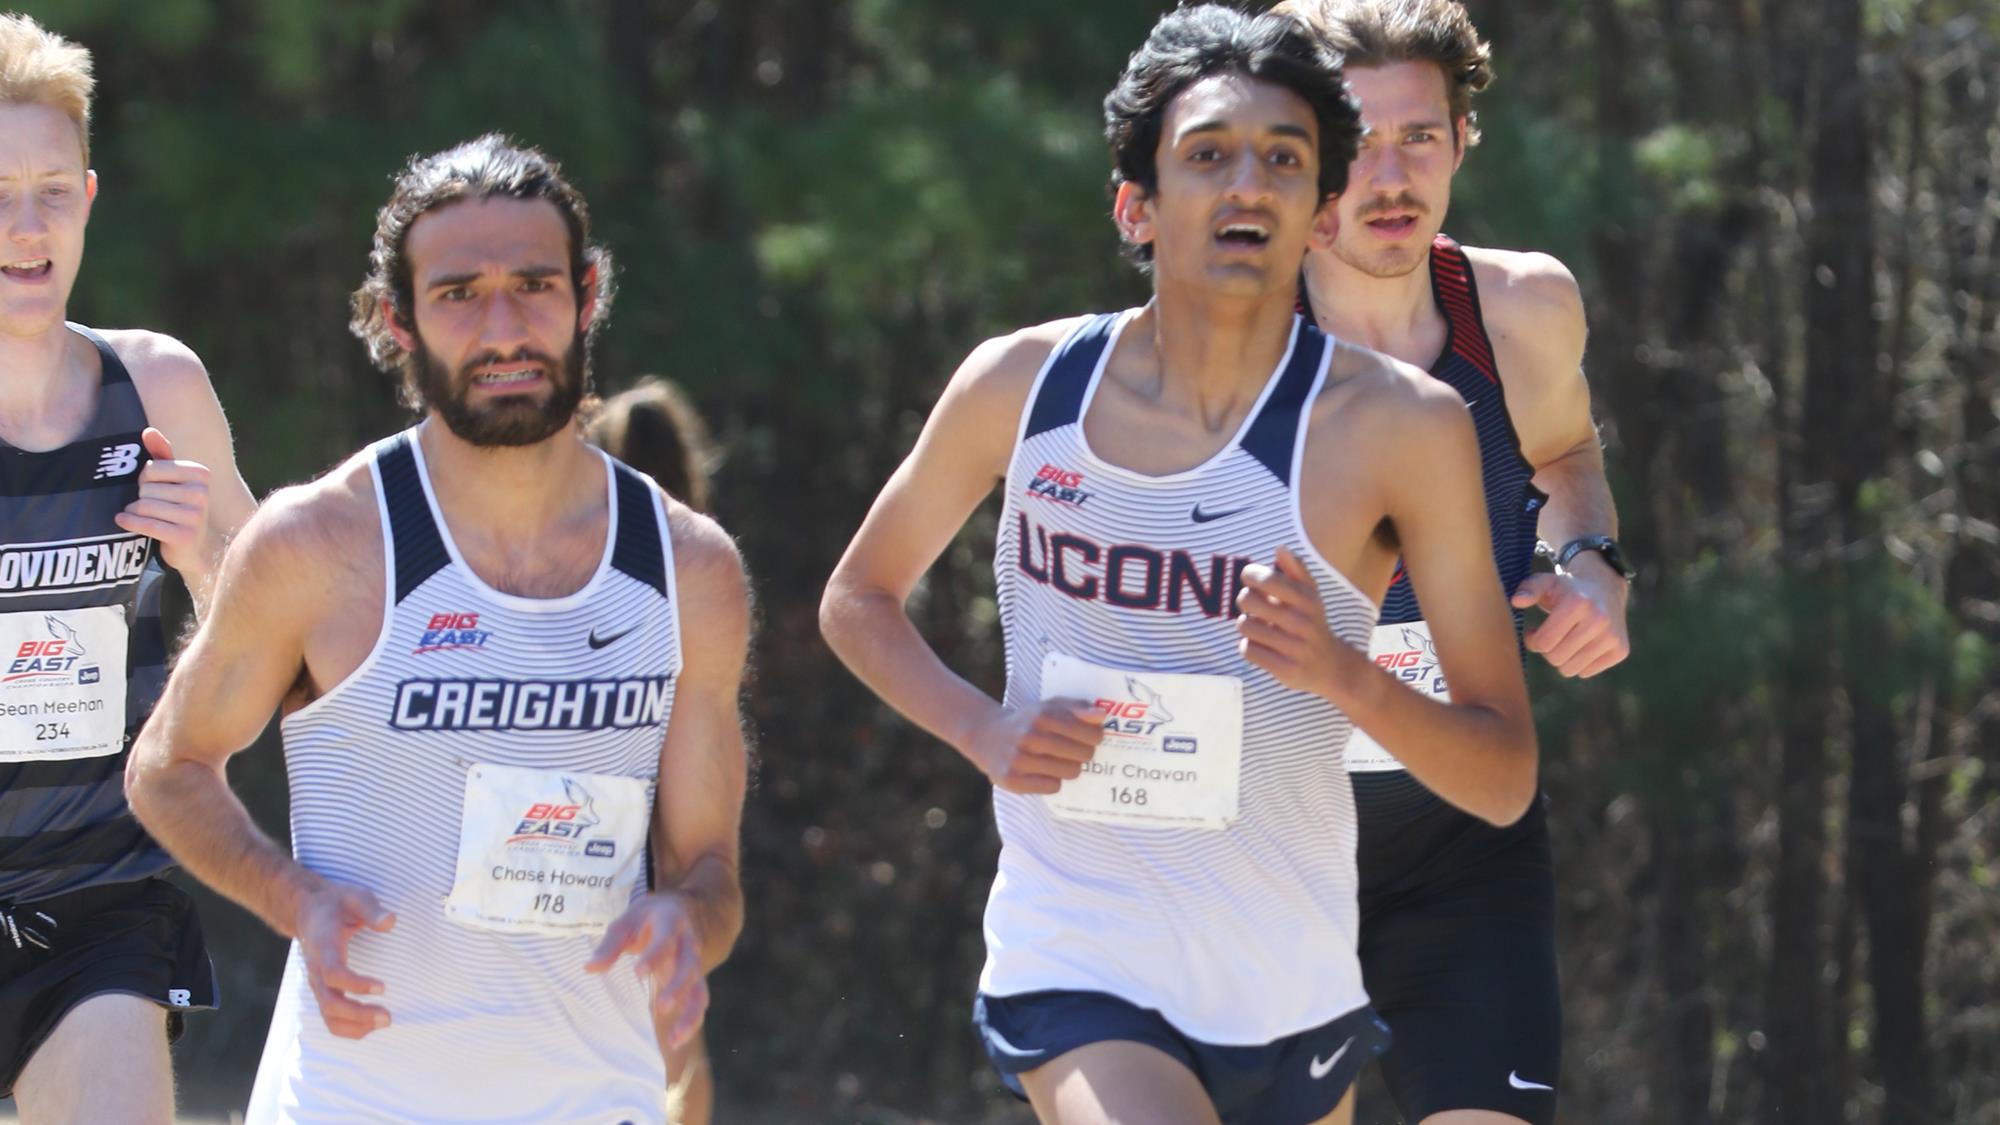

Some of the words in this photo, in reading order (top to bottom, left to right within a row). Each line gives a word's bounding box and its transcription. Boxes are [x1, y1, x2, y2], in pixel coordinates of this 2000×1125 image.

[0, 537, 147, 590] OVIDENCE
[427, 613, 479, 630] BIG
[418, 630, 492, 647] EAST
[17, 640, 67, 658] BIG
[8, 656, 79, 674] EAST
[1375, 651, 1422, 669] BIG
[0, 704, 38, 716] Sean
[43, 699, 104, 714] Meehan
[391, 678, 671, 730] CREIGHTON
[1094, 699, 1149, 718] BIG
[35, 723, 70, 741] 234
[1105, 718, 1164, 735] AST
[1081, 761, 1115, 776] abir
[1122, 764, 1197, 782] Chavan
[1110, 787, 1148, 806] 168
[526, 803, 581, 820] BIG
[513, 820, 591, 838] EAST
[491, 865, 545, 882] Chase
[551, 869, 614, 888] Howard
[533, 894, 565, 914] 178
